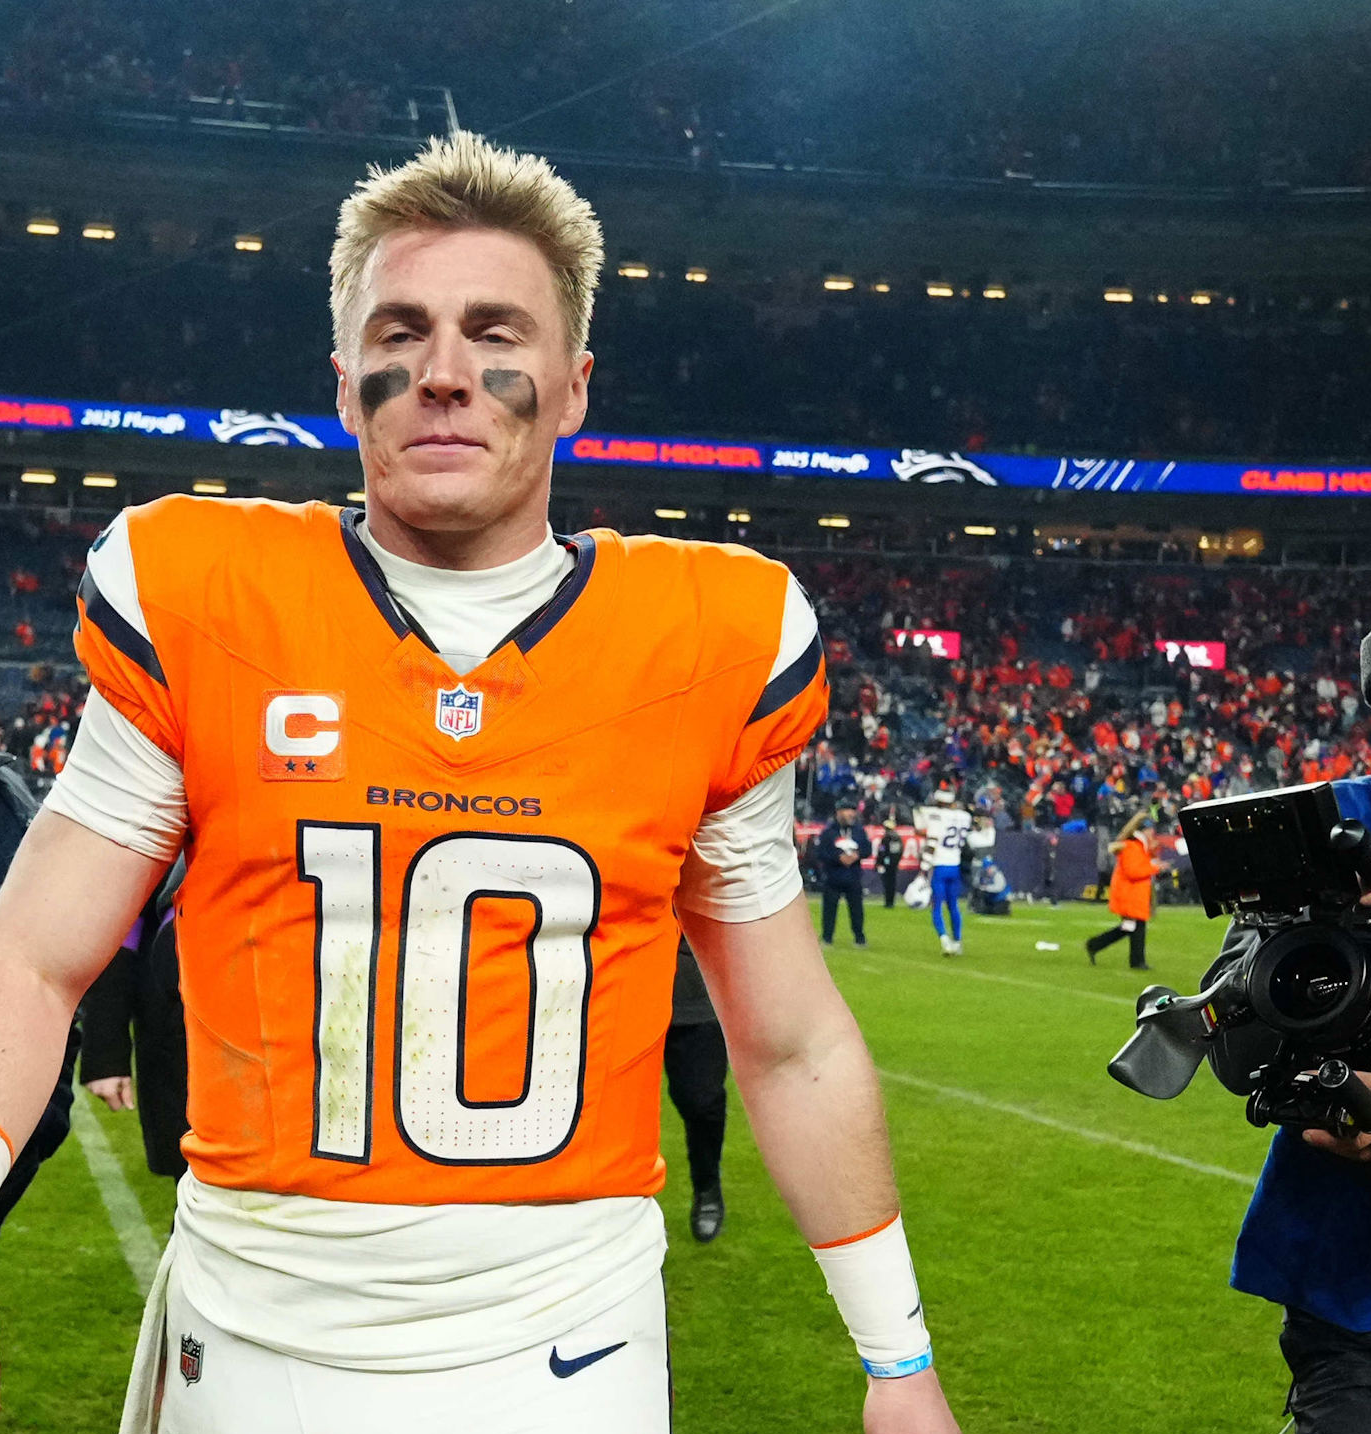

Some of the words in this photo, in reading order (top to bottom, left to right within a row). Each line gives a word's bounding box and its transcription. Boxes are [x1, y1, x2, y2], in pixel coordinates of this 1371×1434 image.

[265, 695, 341, 757] C
[442, 708, 474, 730] NFL
[366, 786, 542, 817] BRONCOS
[296, 819, 601, 1166] 10
